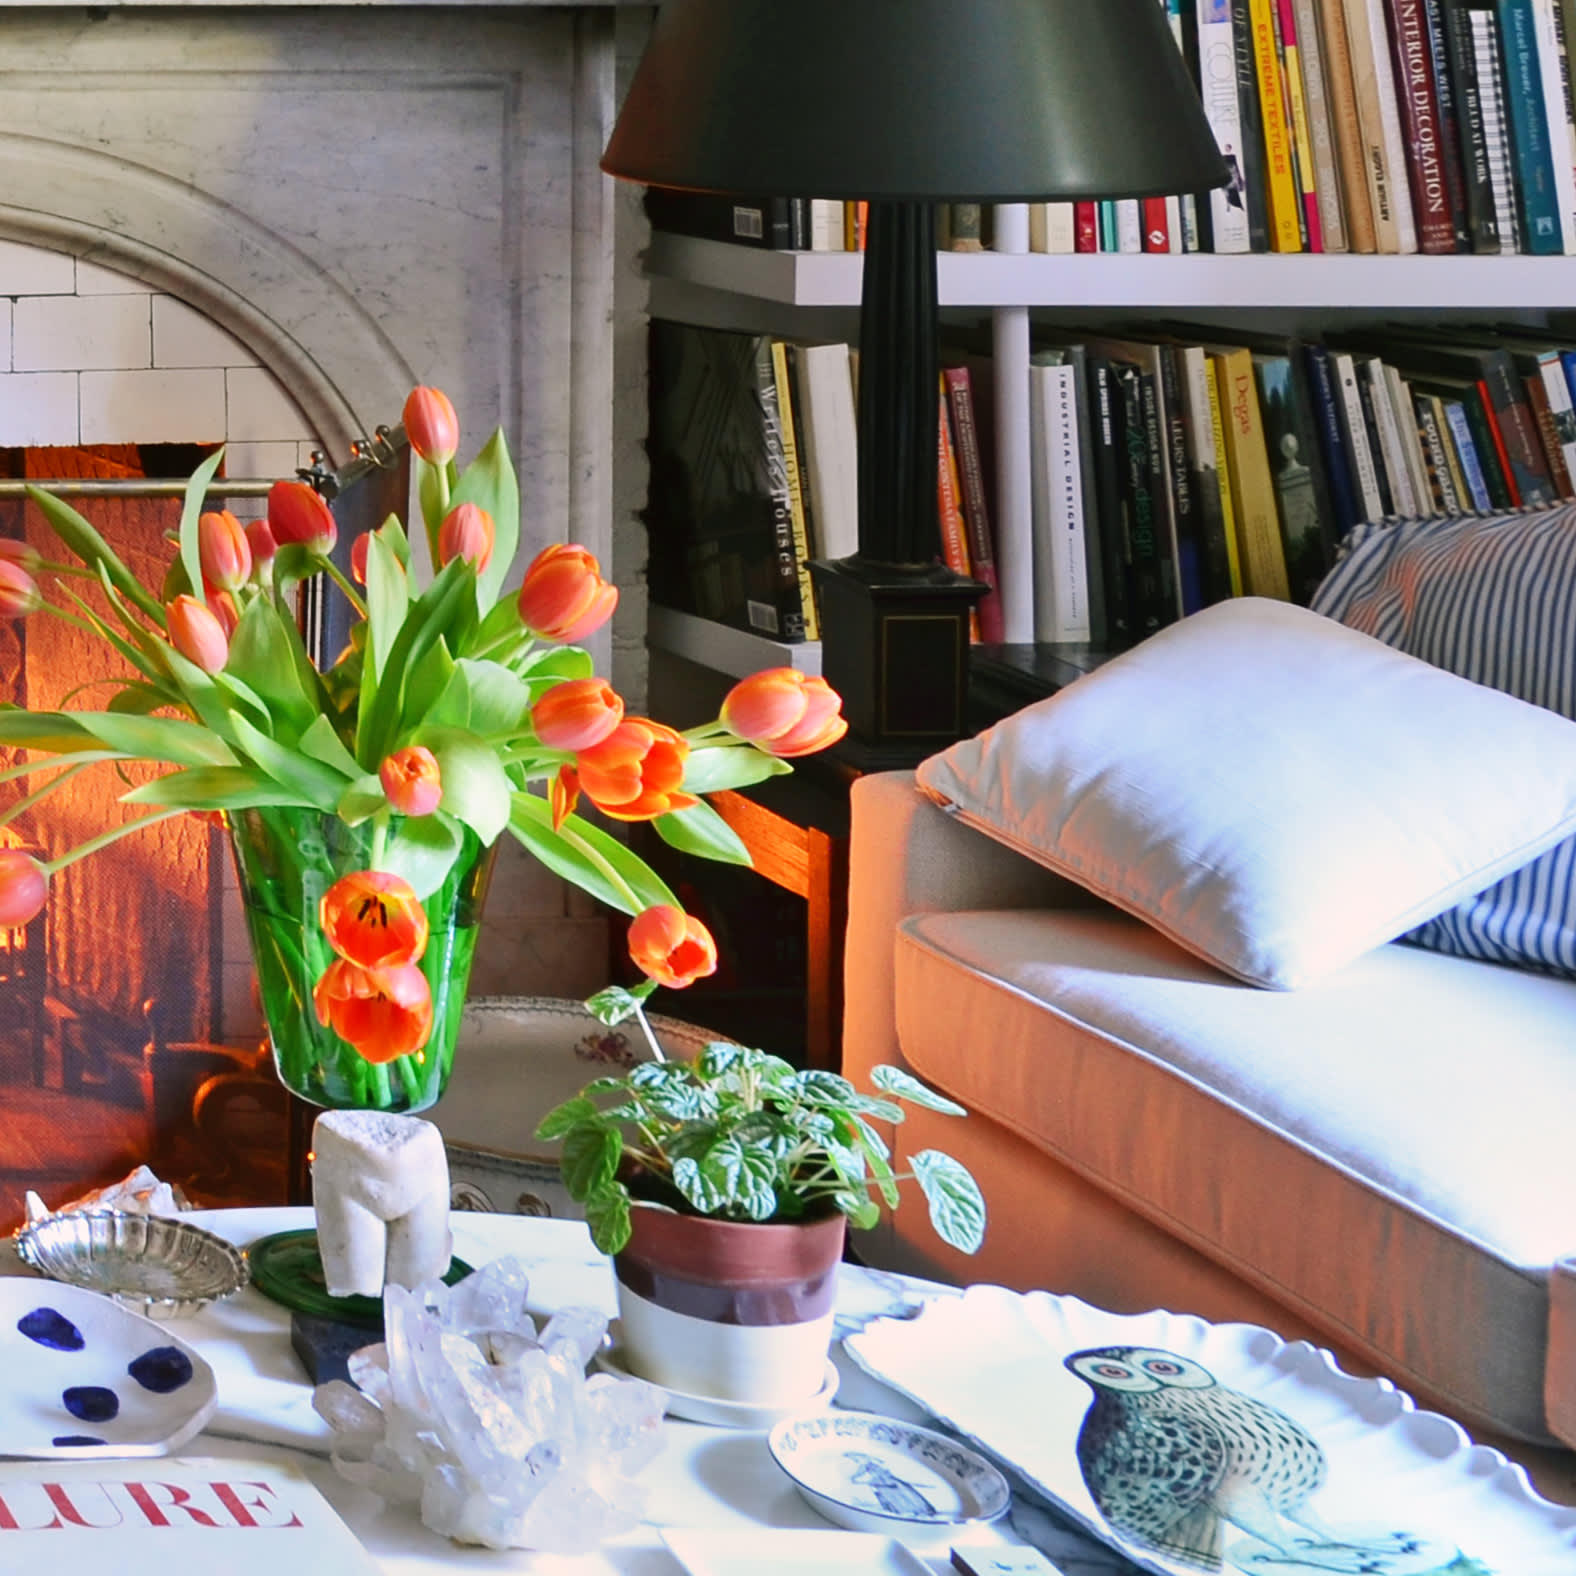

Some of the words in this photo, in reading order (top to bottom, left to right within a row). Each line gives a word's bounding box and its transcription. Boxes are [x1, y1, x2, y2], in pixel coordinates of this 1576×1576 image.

[1257, 23, 1277, 97] EXTREME
[1267, 101, 1285, 175] TEXTILES
[1413, 91, 1443, 213] DECORATION
[1058, 374, 1071, 467] INDUSTRIAL
[1065, 476, 1075, 531] DESIGN
[1234, 375, 1253, 434] Degas
